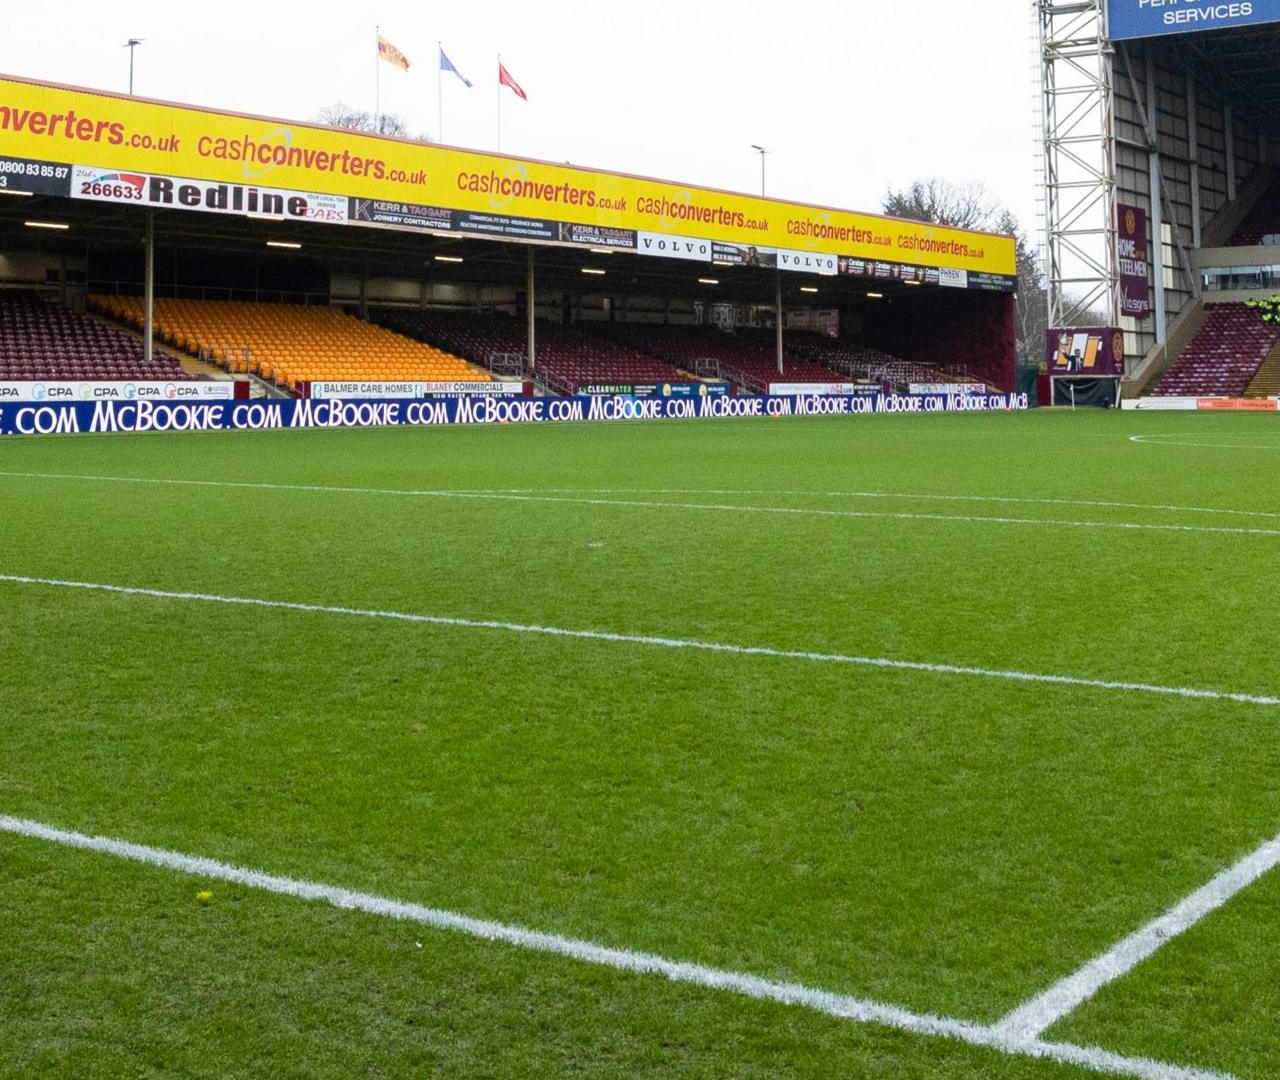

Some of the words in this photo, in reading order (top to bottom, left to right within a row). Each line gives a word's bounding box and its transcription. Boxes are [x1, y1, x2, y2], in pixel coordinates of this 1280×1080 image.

[1163, 2, 1253, 25] SERVICES
[198, 135, 426, 185] cashconverters.co.uk
[26, 164, 40, 176] 83
[41, 166, 55, 178] 85
[55, 167, 69, 179] 87
[81, 181, 143, 200] 266633
[149, 176, 308, 217] Redline
[457, 170, 627, 211] cashconverters.co.uk
[373, 201, 400, 213] KERR
[401, 204, 408, 213] &
[409, 206, 452, 219] TAGGART
[637, 196, 769, 231] cashconverters.co.uk
[373, 214, 403, 224] JOINERY
[404, 218, 452, 229] CONTRACTORS
[573, 224, 593, 234] KERR
[787, 218, 892, 247] cashconverters.co.uk
[643, 238, 707, 255] VOLVO
[898, 233, 985, 259] cashconverters.co.uk
[781, 254, 833, 269] VOLVO
[1119, 261, 1147, 278] TEELMEN
[48, 387, 73, 397] CPA
[94, 387, 118, 397] CPA
[138, 387, 160, 397] CPA
[177, 387, 199, 397] CPA
[324, 384, 358, 393] BALMER
[361, 384, 383, 393] CARE
[385, 384, 413, 393] HOMES
[426, 383, 452, 391] BLANEY
[453, 382, 504, 392] COMMERCIALS
